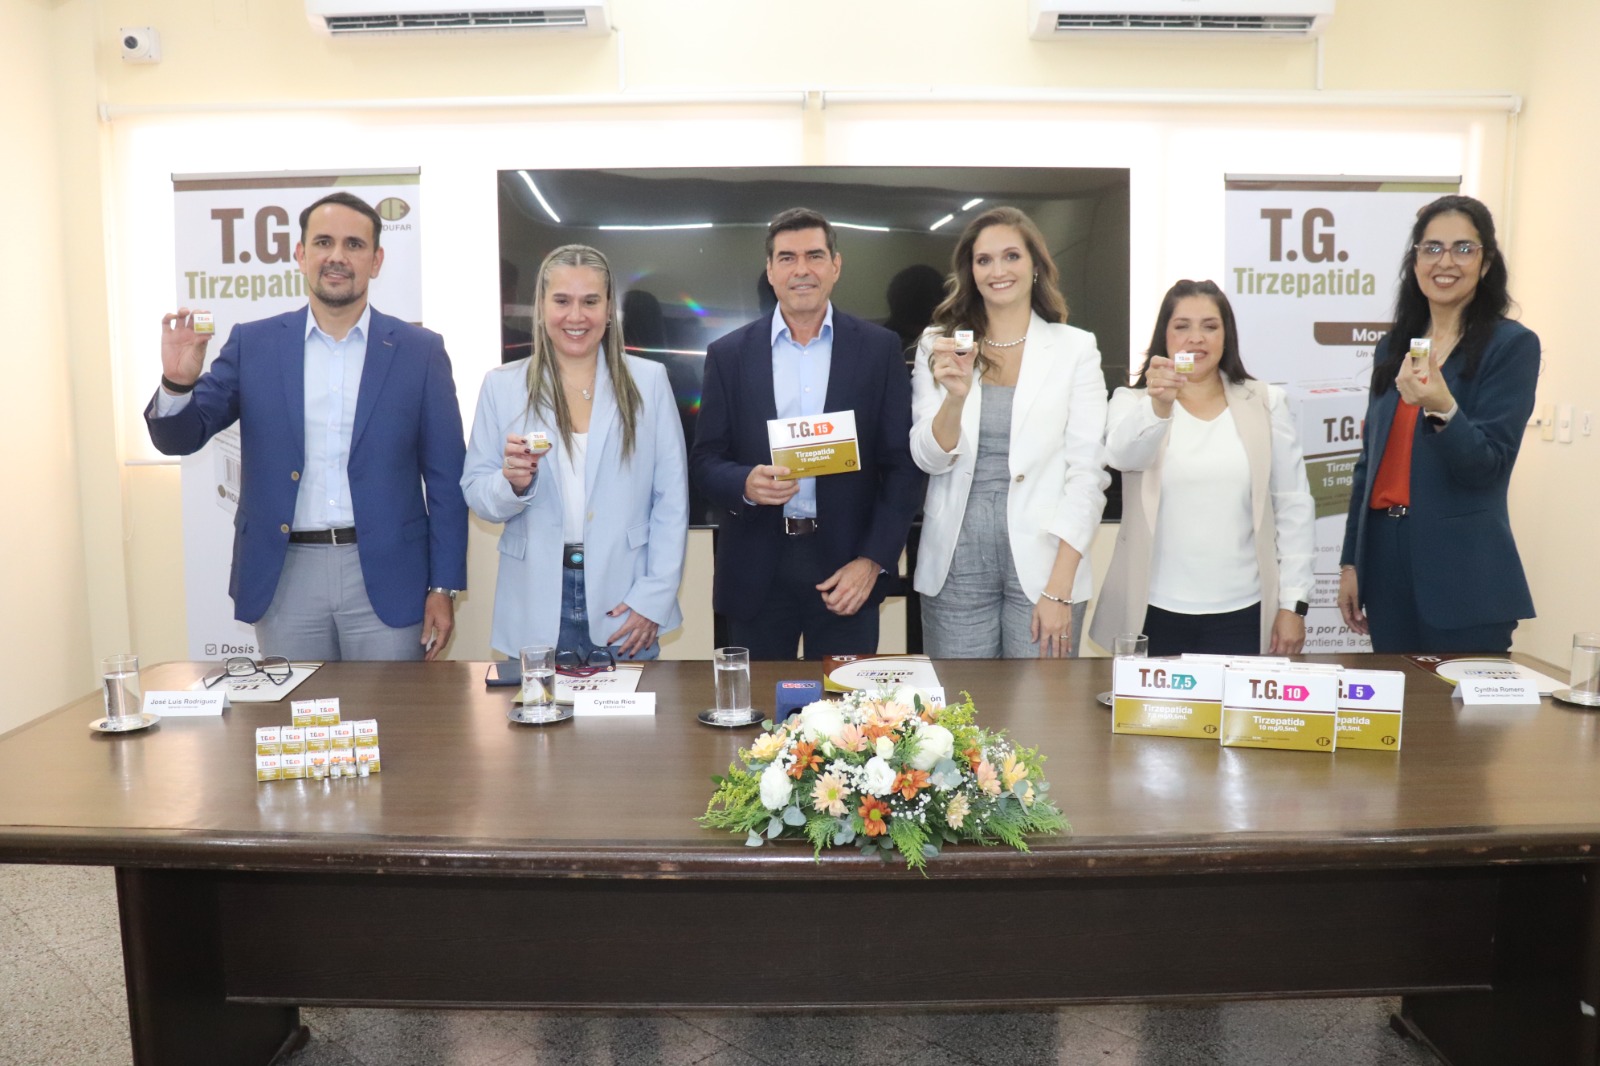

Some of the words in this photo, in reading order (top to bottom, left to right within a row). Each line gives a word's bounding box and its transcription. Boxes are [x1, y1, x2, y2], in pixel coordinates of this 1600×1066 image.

[1260, 208, 1349, 263] T.G.
[1233, 267, 1376, 298] Tirzepatida
[787, 421, 814, 439] T.G.
[817, 424, 828, 434] 15
[1323, 416, 1359, 443] T.G.
[795, 448, 835, 458] Tirzepatida
[1322, 476, 1334, 488] 15
[1316, 626, 1337, 636] por
[1347, 637, 1356, 647] la
[221, 643, 255, 654] Dosis
[1139, 668, 1171, 689] T.G.
[1173, 677, 1192, 690] 7,5
[1249, 679, 1283, 700] T.G.
[1286, 688, 1301, 699] 10
[1355, 686, 1364, 698] 5
[1474, 686, 1499, 694] Cynthia
[1142, 704, 1193, 715] Tirzepatida
[1252, 715, 1305, 727] Tirzepatida
